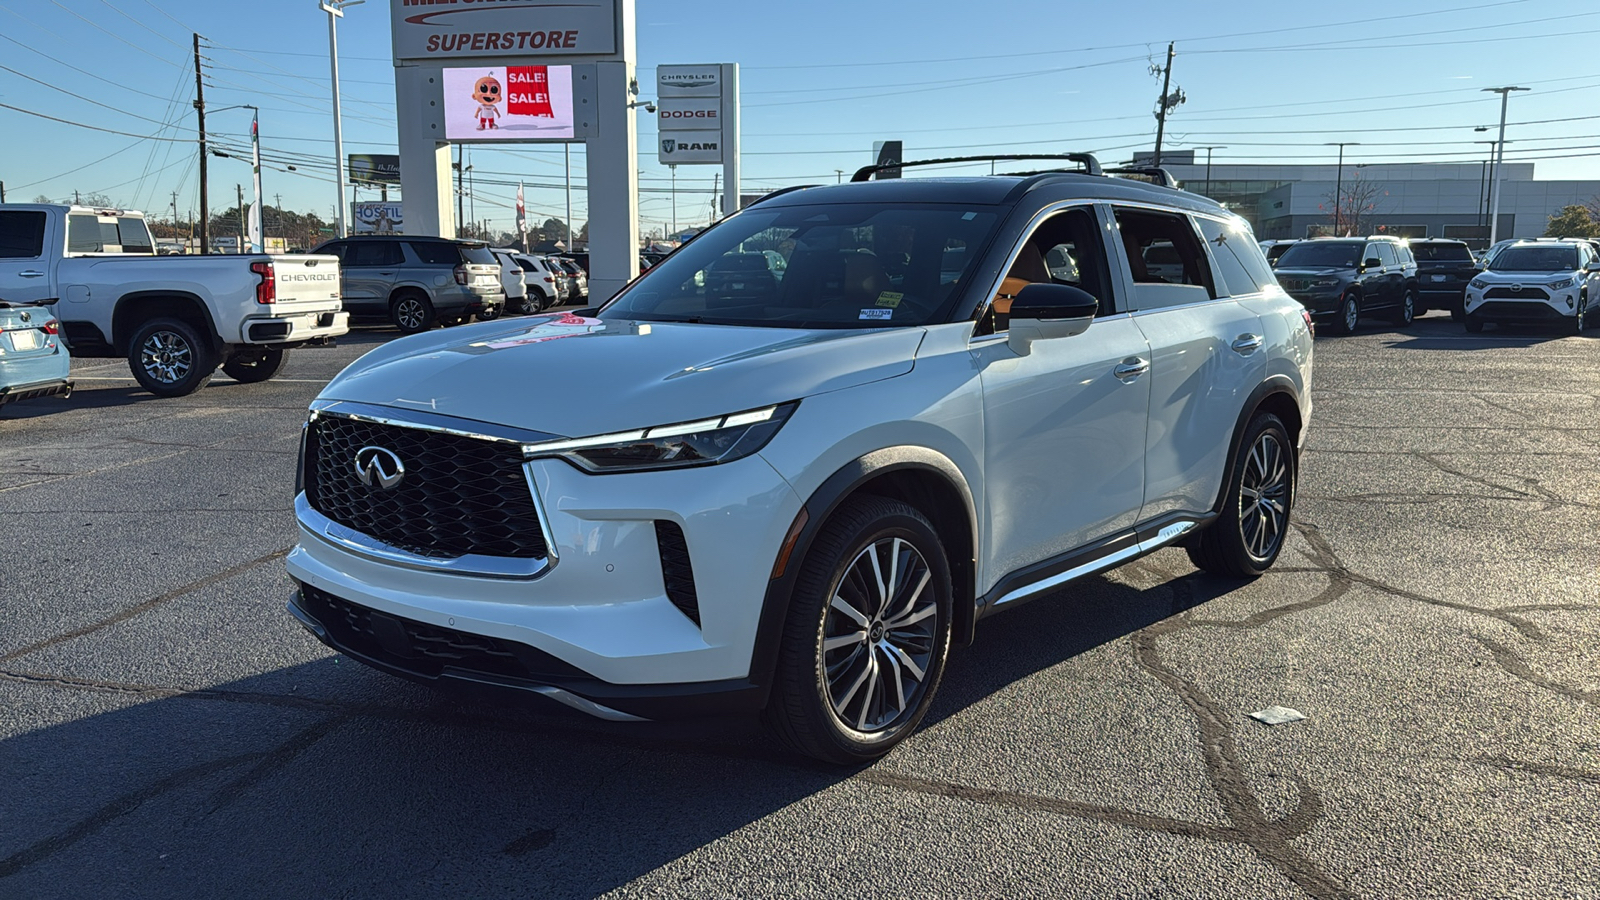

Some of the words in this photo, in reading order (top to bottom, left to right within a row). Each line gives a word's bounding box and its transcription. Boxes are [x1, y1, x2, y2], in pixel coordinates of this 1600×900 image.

[426, 30, 579, 52] SUPERSTORE
[508, 72, 546, 84] SALE!
[509, 92, 549, 104] SALE!
[660, 110, 717, 119] DODGE
[677, 142, 718, 151] RAM
[281, 273, 337, 282] CHEVROLET
